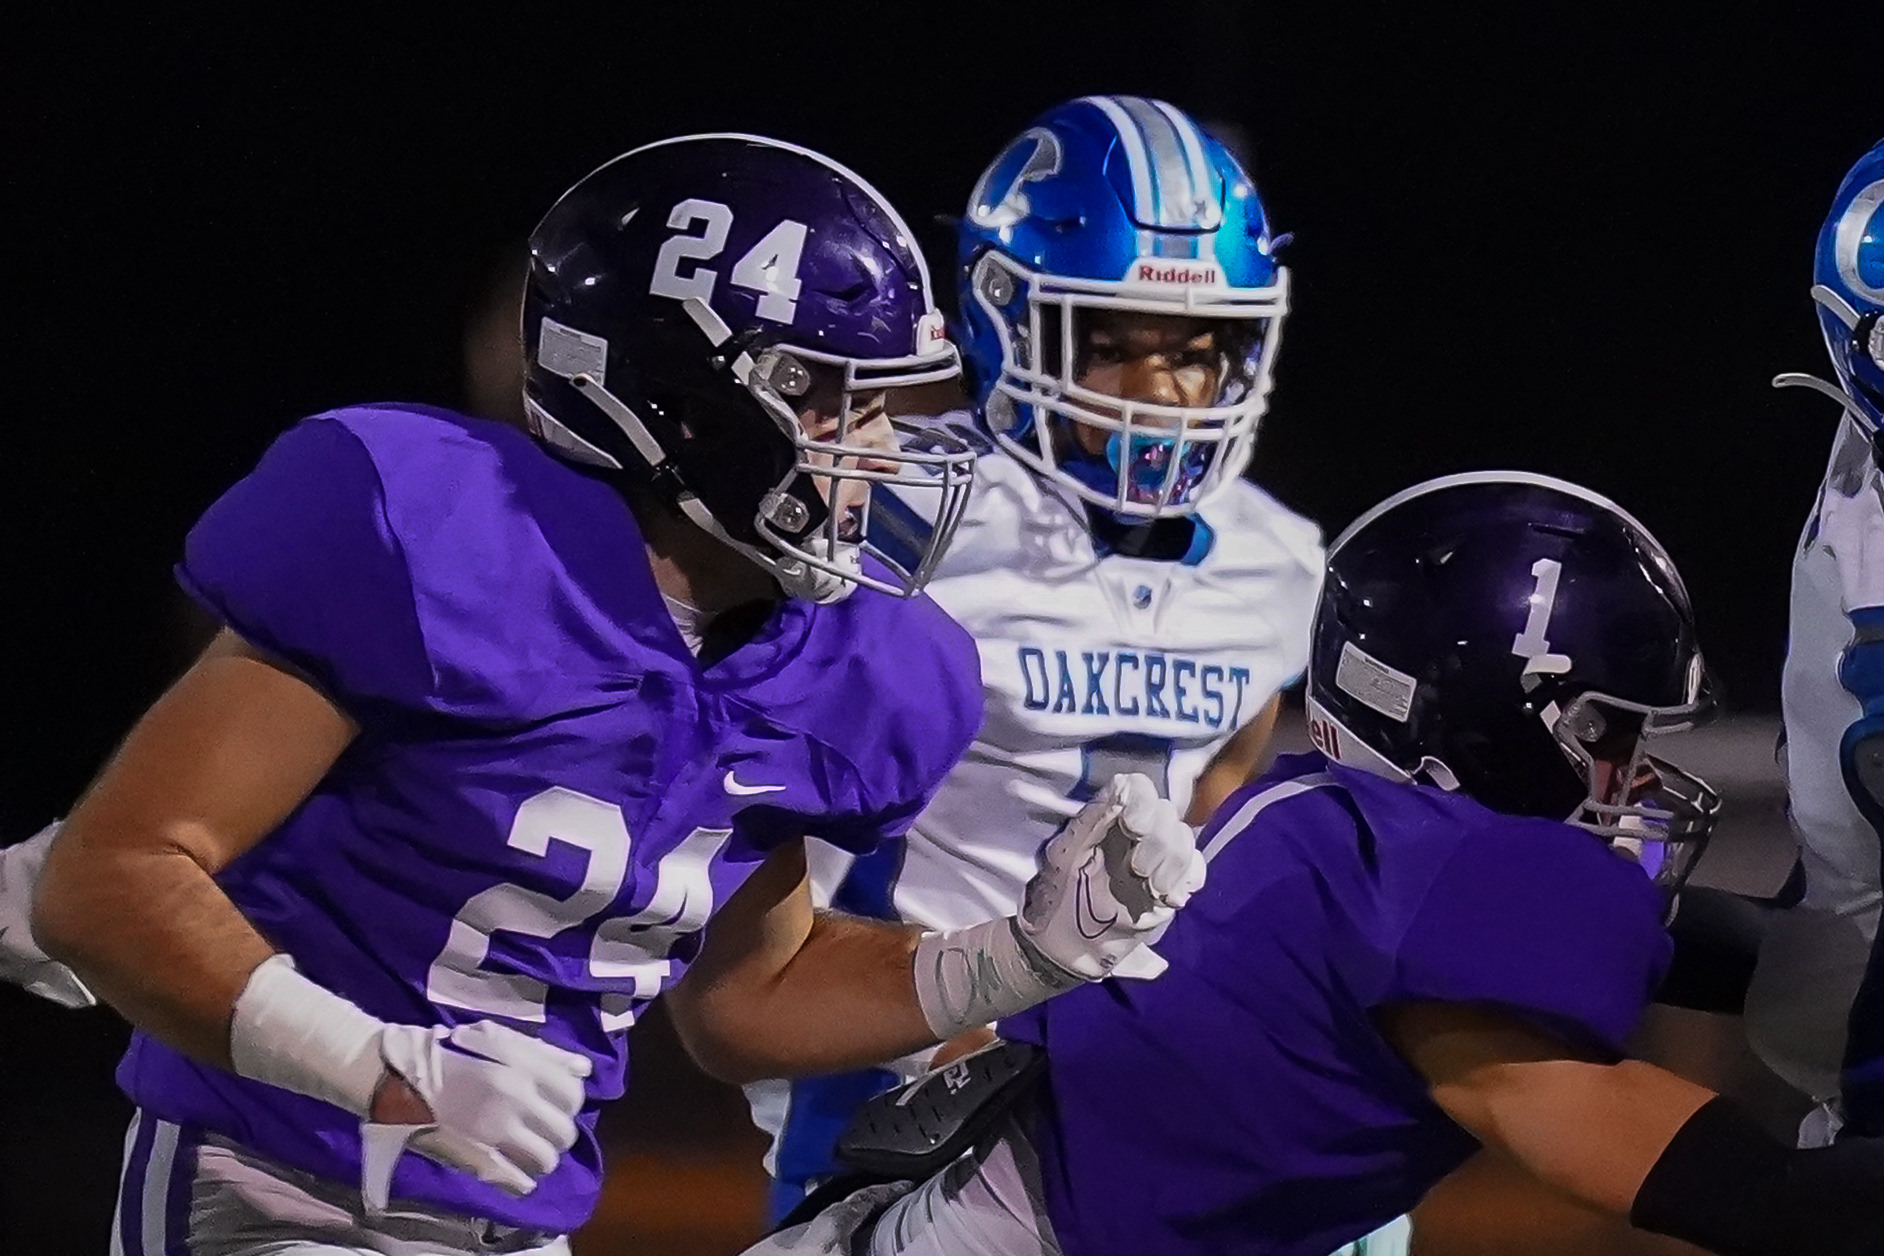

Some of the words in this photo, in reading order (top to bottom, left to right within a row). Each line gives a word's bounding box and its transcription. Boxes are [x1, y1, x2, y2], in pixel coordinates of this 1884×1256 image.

[649, 198, 808, 325] 24
[1138, 265, 1215, 284] Riddell
[1511, 558, 1562, 658] 1
[1018, 646, 1250, 730] OAKCREST
[427, 785, 734, 1033] 24
